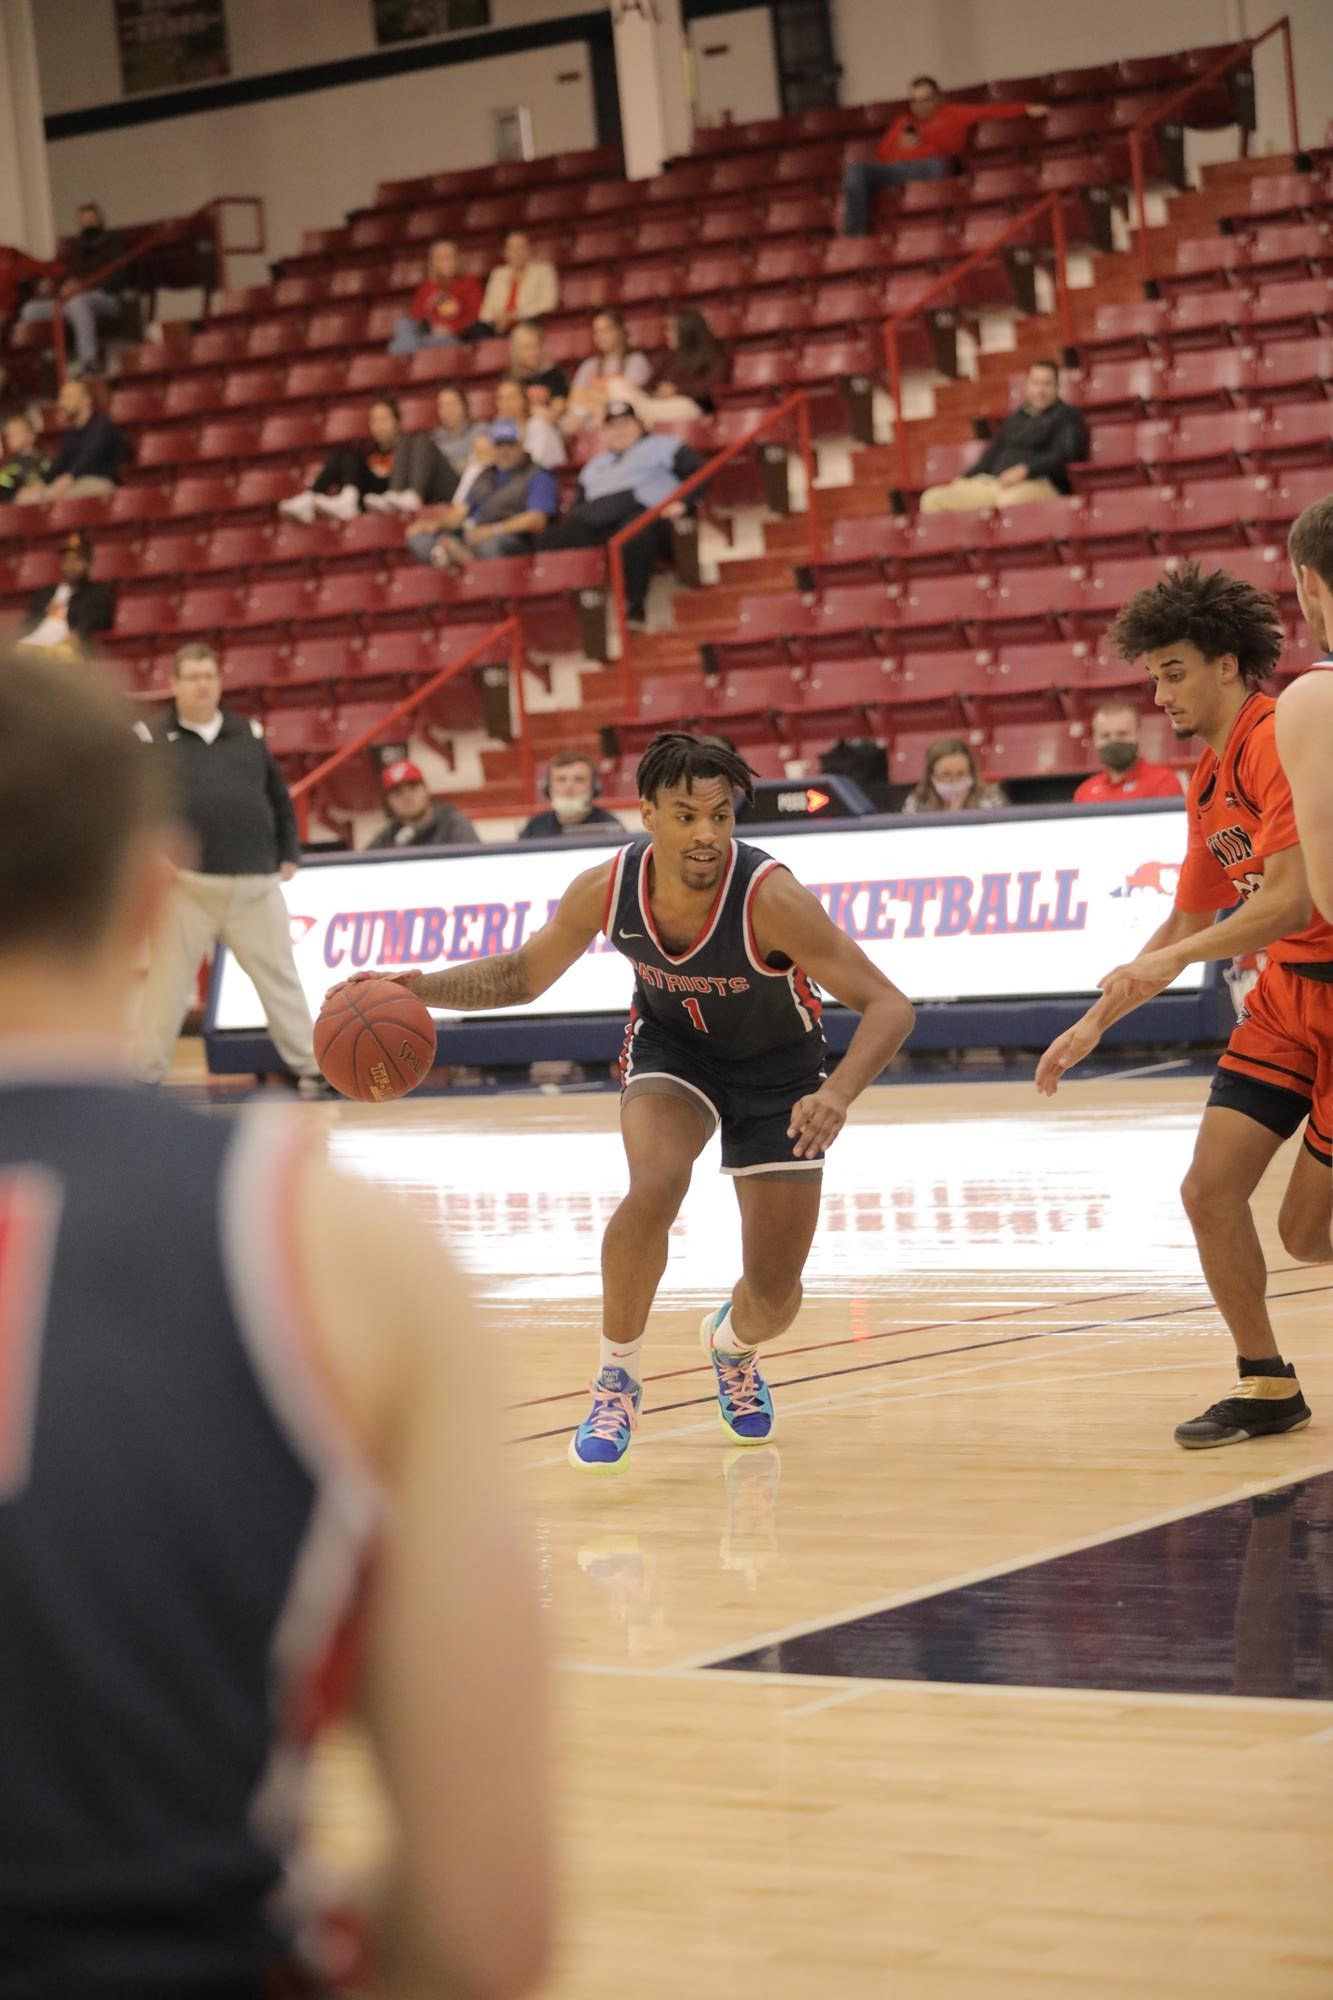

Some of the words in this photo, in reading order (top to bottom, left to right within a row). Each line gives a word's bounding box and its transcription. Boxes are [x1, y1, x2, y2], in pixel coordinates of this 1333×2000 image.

[1206, 824, 1256, 869] NION
[322, 897, 619, 969] CUMBERL
[803, 868, 1088, 941] KETBALL
[630, 957, 750, 997] ATRIOTS
[681, 997, 710, 1034] 1
